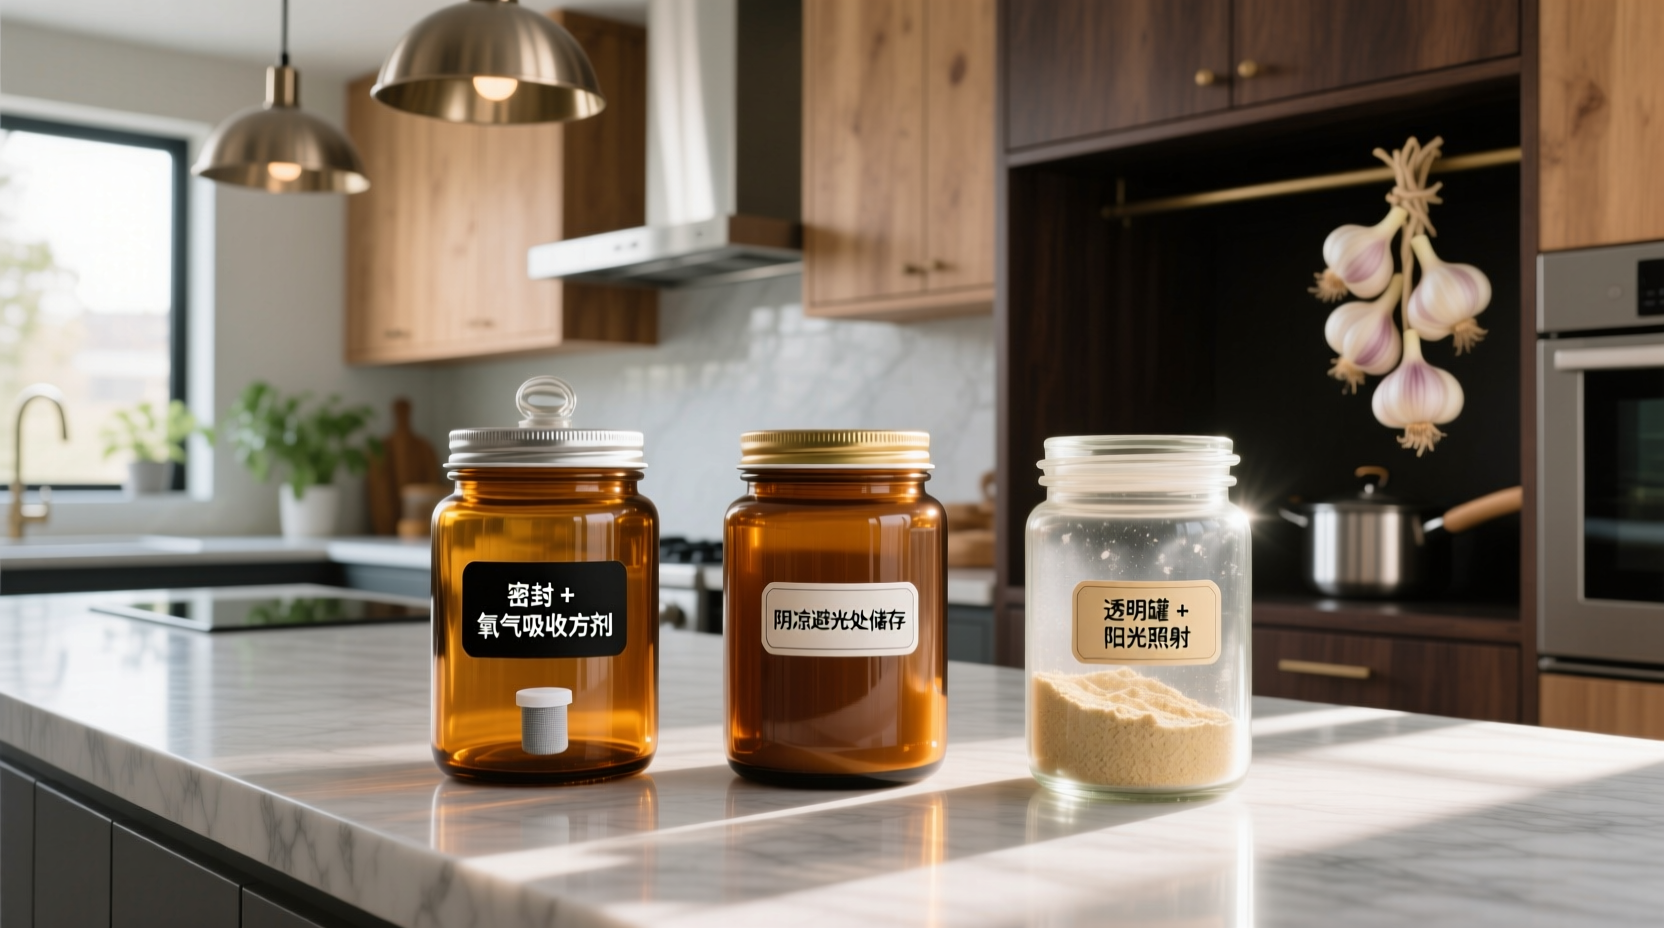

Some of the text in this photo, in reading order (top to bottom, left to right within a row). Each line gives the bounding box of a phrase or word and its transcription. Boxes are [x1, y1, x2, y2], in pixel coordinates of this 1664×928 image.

[507, 581, 575, 608] 密封 +
[773, 608, 906, 632] 阴凉避光处储存
[1103, 597, 1190, 622] 透明罐 +
[477, 611, 613, 640] 氧气吸收方剂
[1104, 625, 1191, 650] 阳光照射
